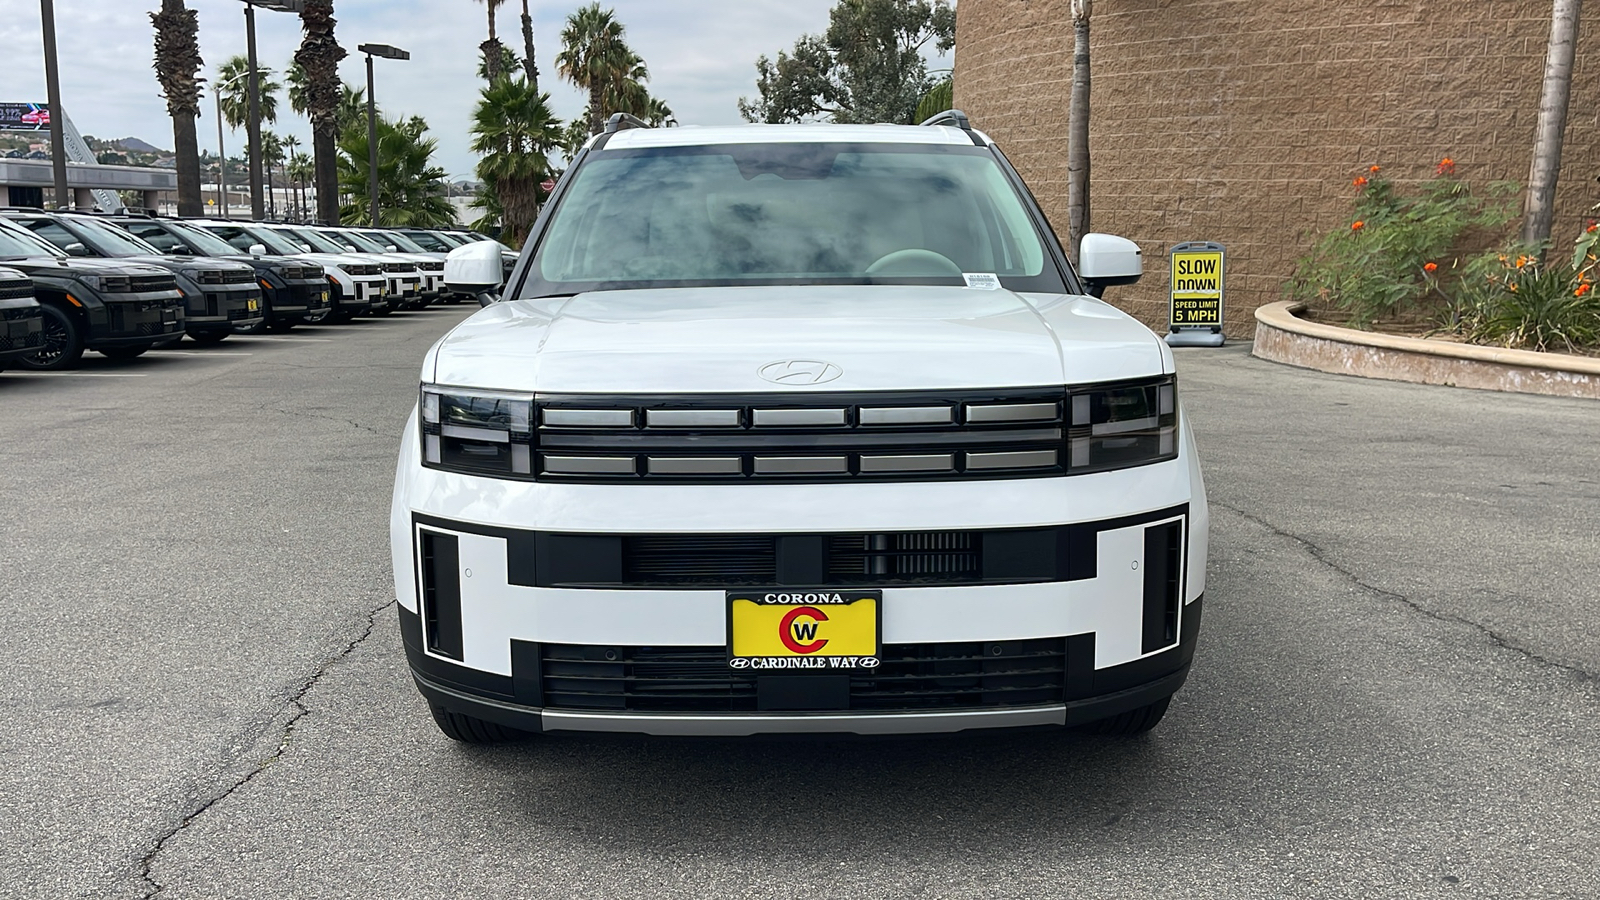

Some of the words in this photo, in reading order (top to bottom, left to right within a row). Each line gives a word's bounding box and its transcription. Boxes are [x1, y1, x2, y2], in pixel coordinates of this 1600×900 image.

[1178, 260, 1216, 275] SLOW
[1178, 279, 1216, 290] DOWN
[1176, 311, 1183, 321] 5
[1188, 311, 1216, 321] MPH
[764, 593, 844, 604] CORONA
[751, 658, 826, 669] CARDINALE
[830, 657, 859, 668] WAY
